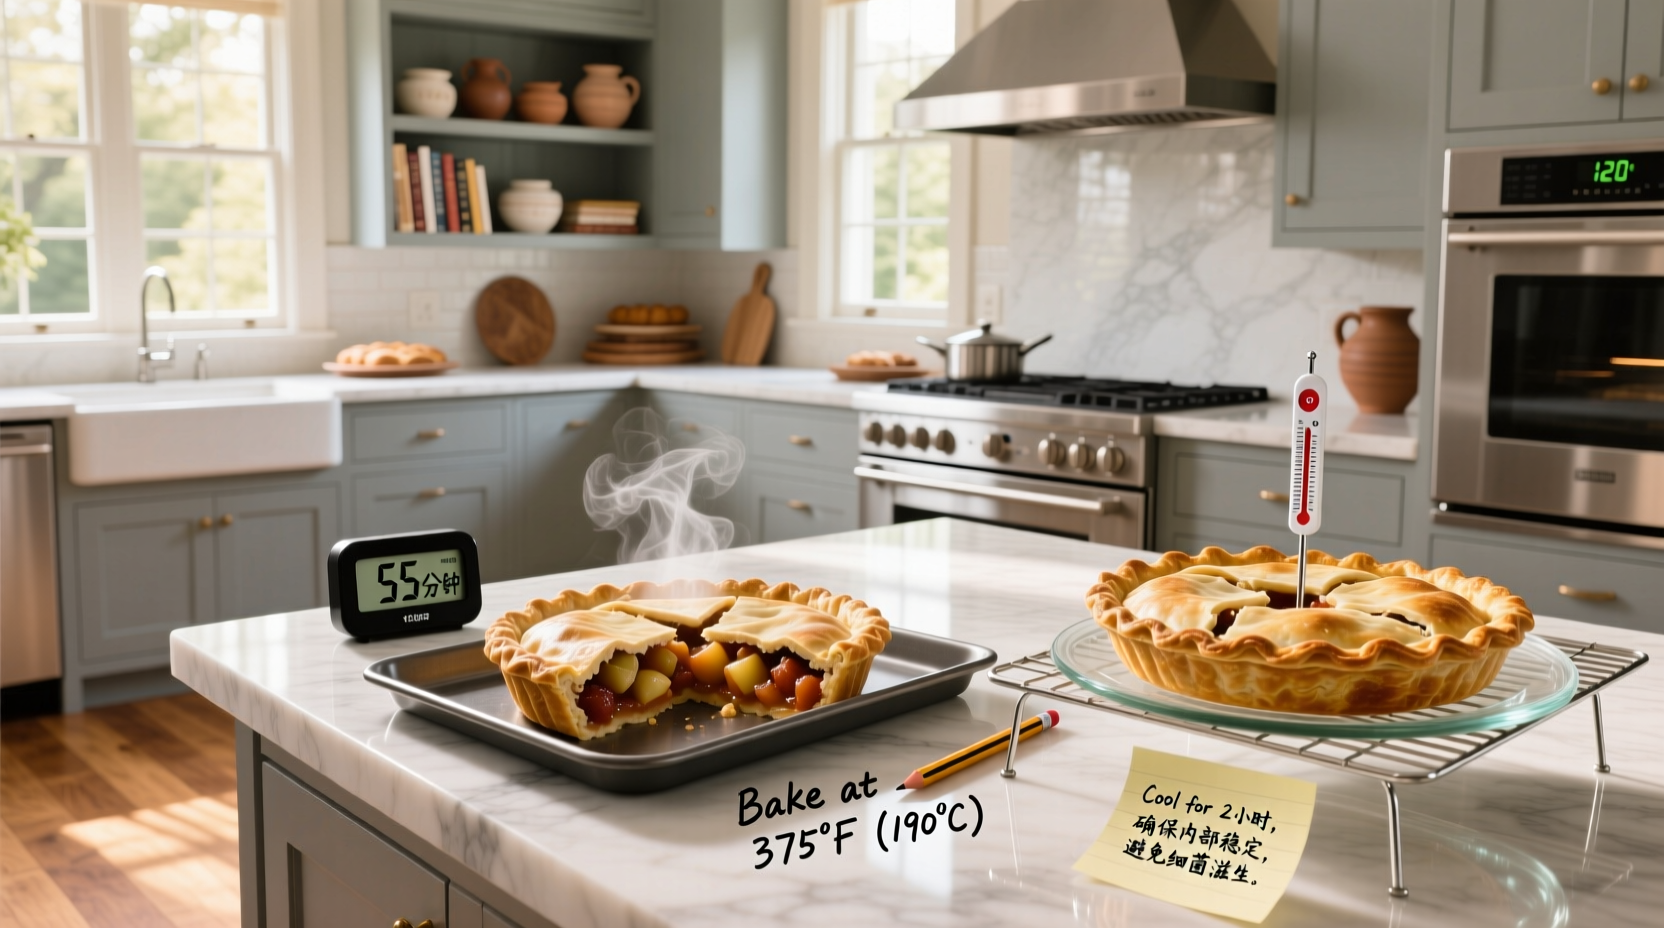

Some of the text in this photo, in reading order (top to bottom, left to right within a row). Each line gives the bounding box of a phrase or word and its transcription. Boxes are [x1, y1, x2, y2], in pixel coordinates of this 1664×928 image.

[377, 560, 460, 604] 55分钟
[738, 771, 877, 826] Bake at
[1142, 784, 1181, 810] Cool
[1185, 795, 1213, 815] for
[752, 794, 983, 869] 375°F (190°C)
